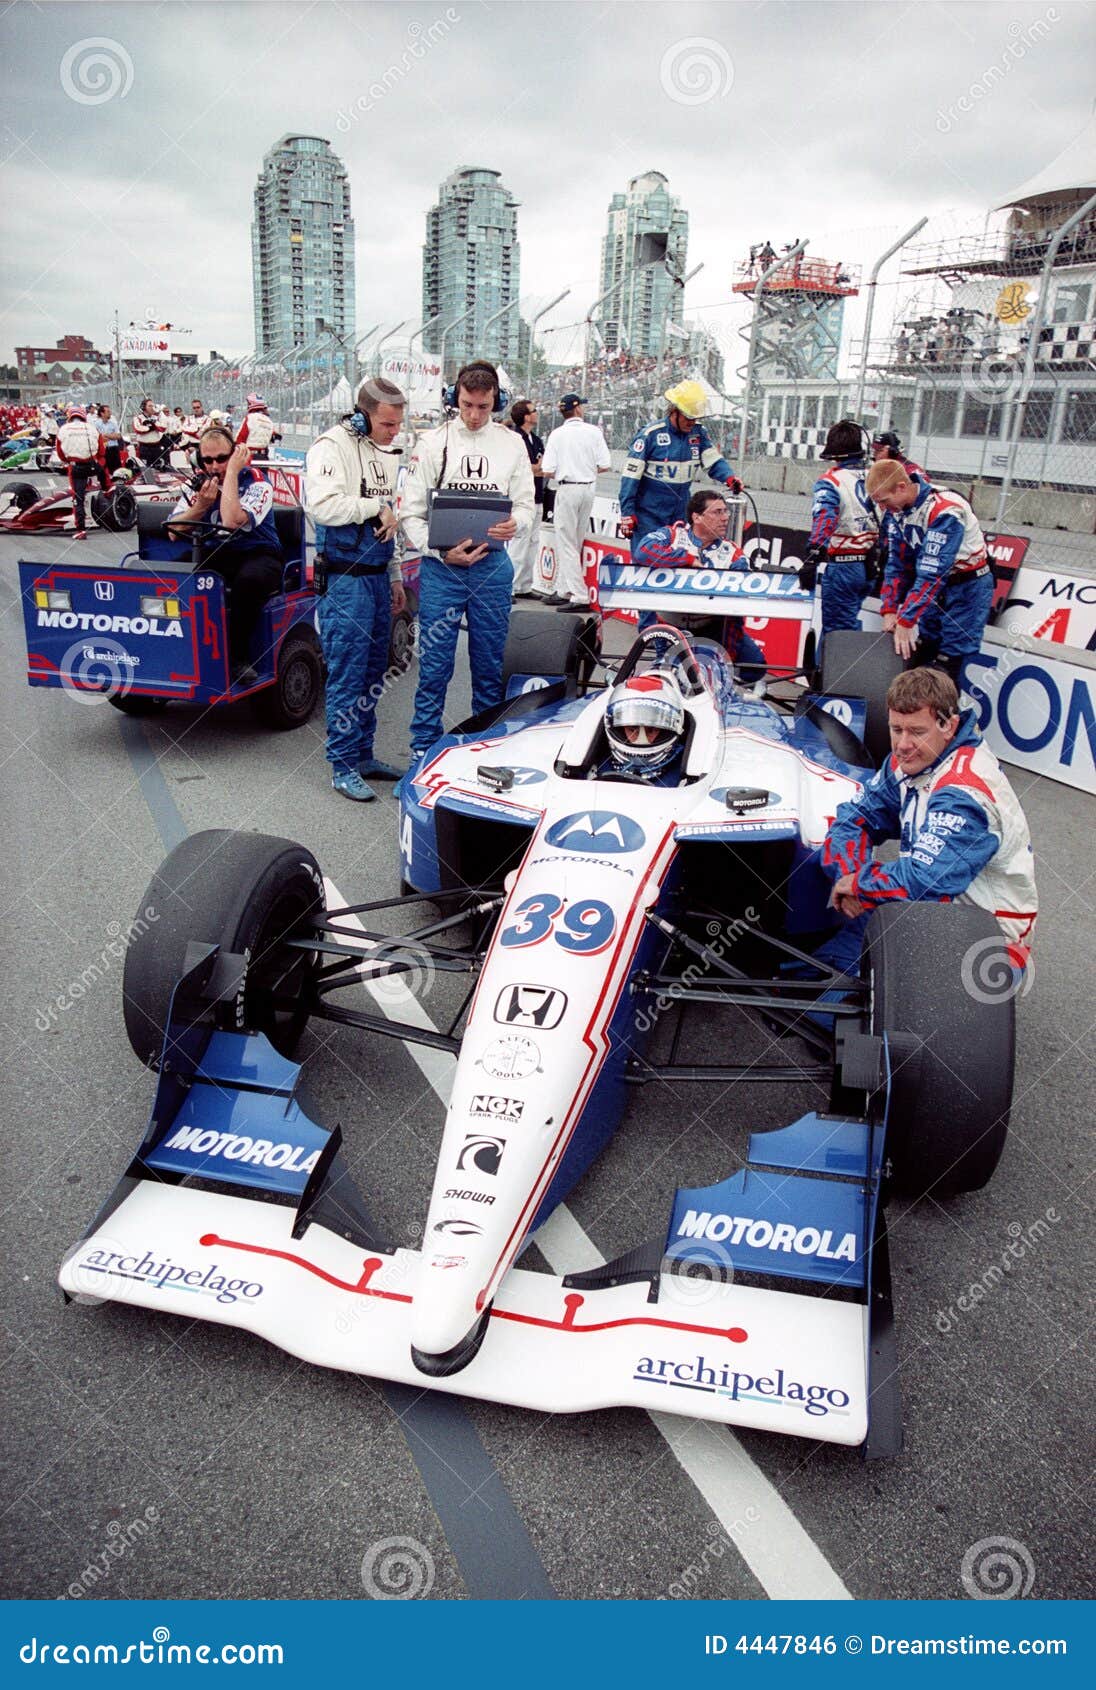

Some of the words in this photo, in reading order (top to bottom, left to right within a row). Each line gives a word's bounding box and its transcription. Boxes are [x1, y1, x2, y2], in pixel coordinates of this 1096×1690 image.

[447, 482, 499, 491] HONDA
[197, 577, 214, 590] 39
[616, 565, 811, 596] MOTOROLA
[37, 610, 184, 638] MOTOROLA
[676, 821, 794, 838] BRIDGESTONE
[530, 855, 635, 878] MOTOROLA
[500, 893, 617, 957] 39
[471, 1096, 524, 1118] NGK
[164, 1125, 321, 1175] MOTOROLA
[443, 1188, 497, 1206] SHOWA
[677, 1209, 857, 1262] MOTOROLA
[86, 1250, 264, 1304] archipelago
[636, 1355, 850, 1416] archipelago
